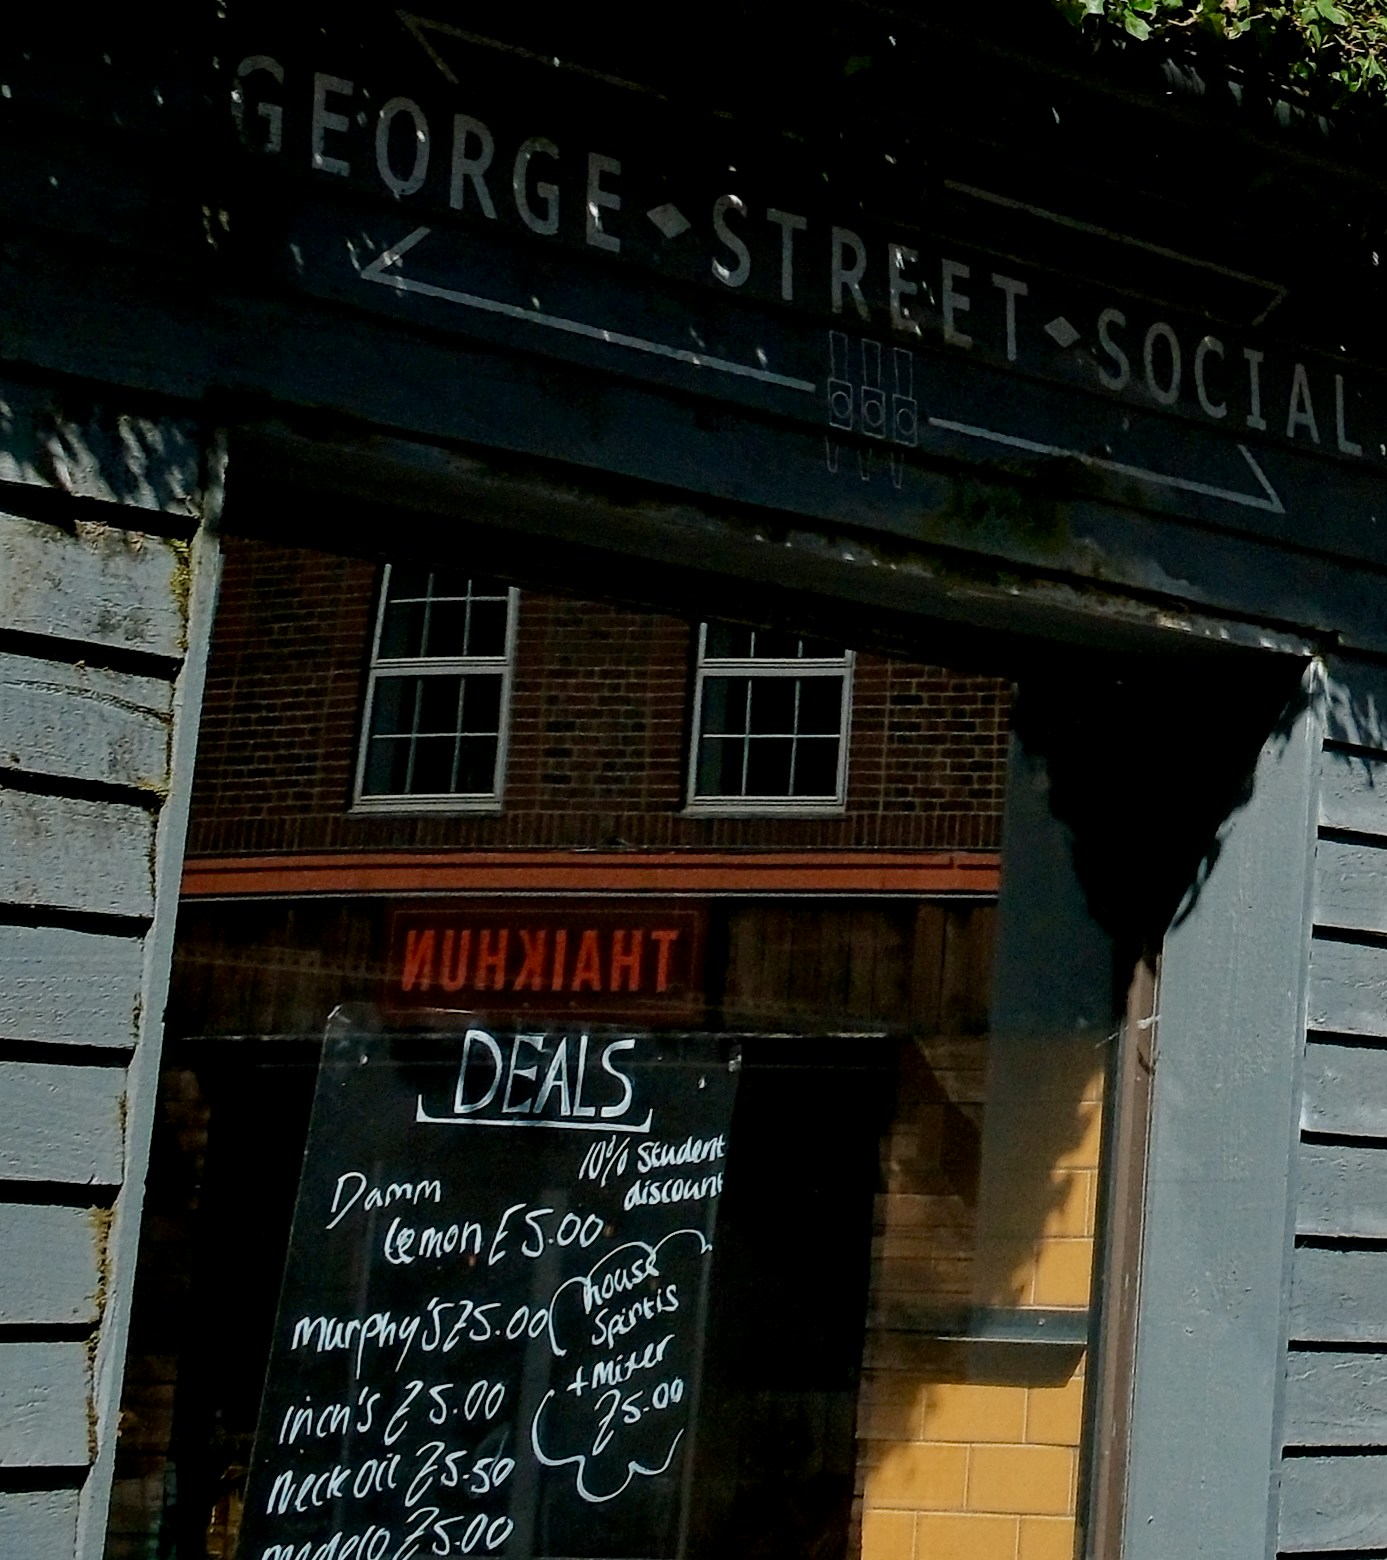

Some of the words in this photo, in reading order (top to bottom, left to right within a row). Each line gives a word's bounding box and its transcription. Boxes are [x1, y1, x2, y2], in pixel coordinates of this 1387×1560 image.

[232, 53, 623, 258] GEORGE
[711, 193, 1027, 366] STREET
[1094, 305, 1365, 459] SOCIAL
[453, 1029, 636, 1118] DEALS
[578, 1134, 631, 1188] 10%
[326, 1171, 442, 1230] Damm
[623, 1171, 724, 1211] discount
